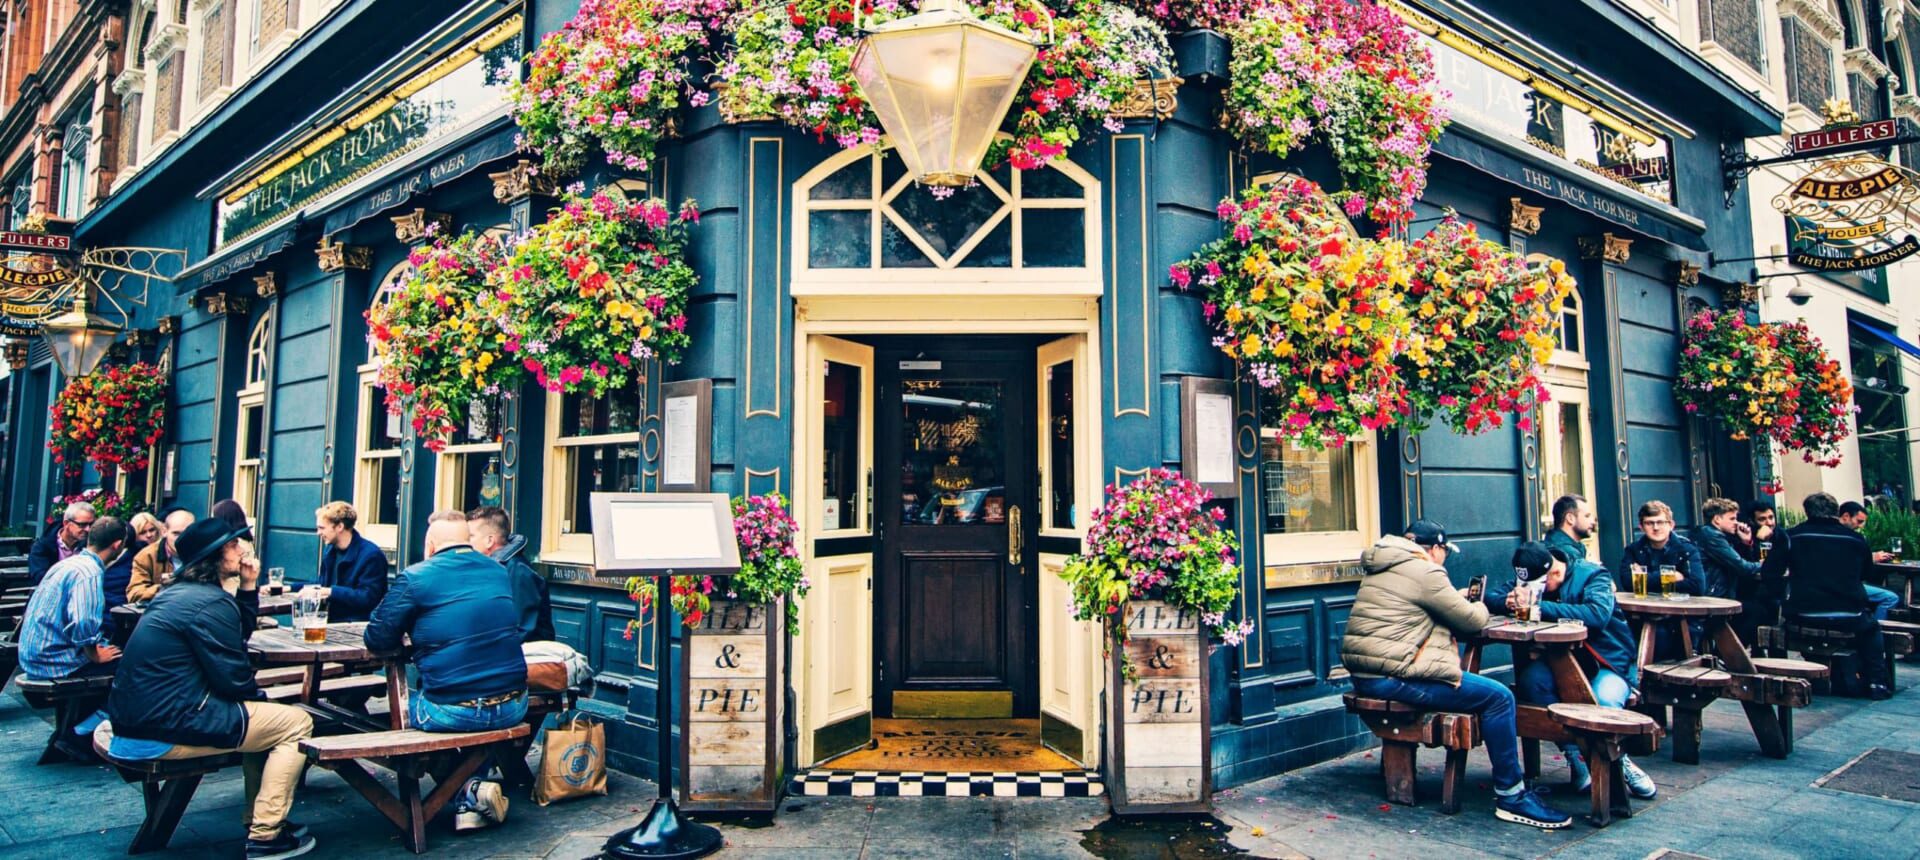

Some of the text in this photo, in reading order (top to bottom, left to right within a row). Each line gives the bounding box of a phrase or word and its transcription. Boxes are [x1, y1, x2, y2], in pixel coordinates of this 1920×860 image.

[1798, 123, 1889, 149] FULLER'S
[249, 99, 434, 217] THE JACK HORNE
[371, 188, 393, 210] THE
[1522, 167, 1639, 226] THE JACK HORNER
[1827, 224, 1879, 239] HOUSE
[1798, 241, 1916, 270] THE JACK HORNER
[1127, 605, 1196, 630] ALE
[715, 644, 741, 669] &
[1148, 644, 1174, 670] &
[694, 688, 761, 713] PIE
[1132, 688, 1194, 714] PIE
